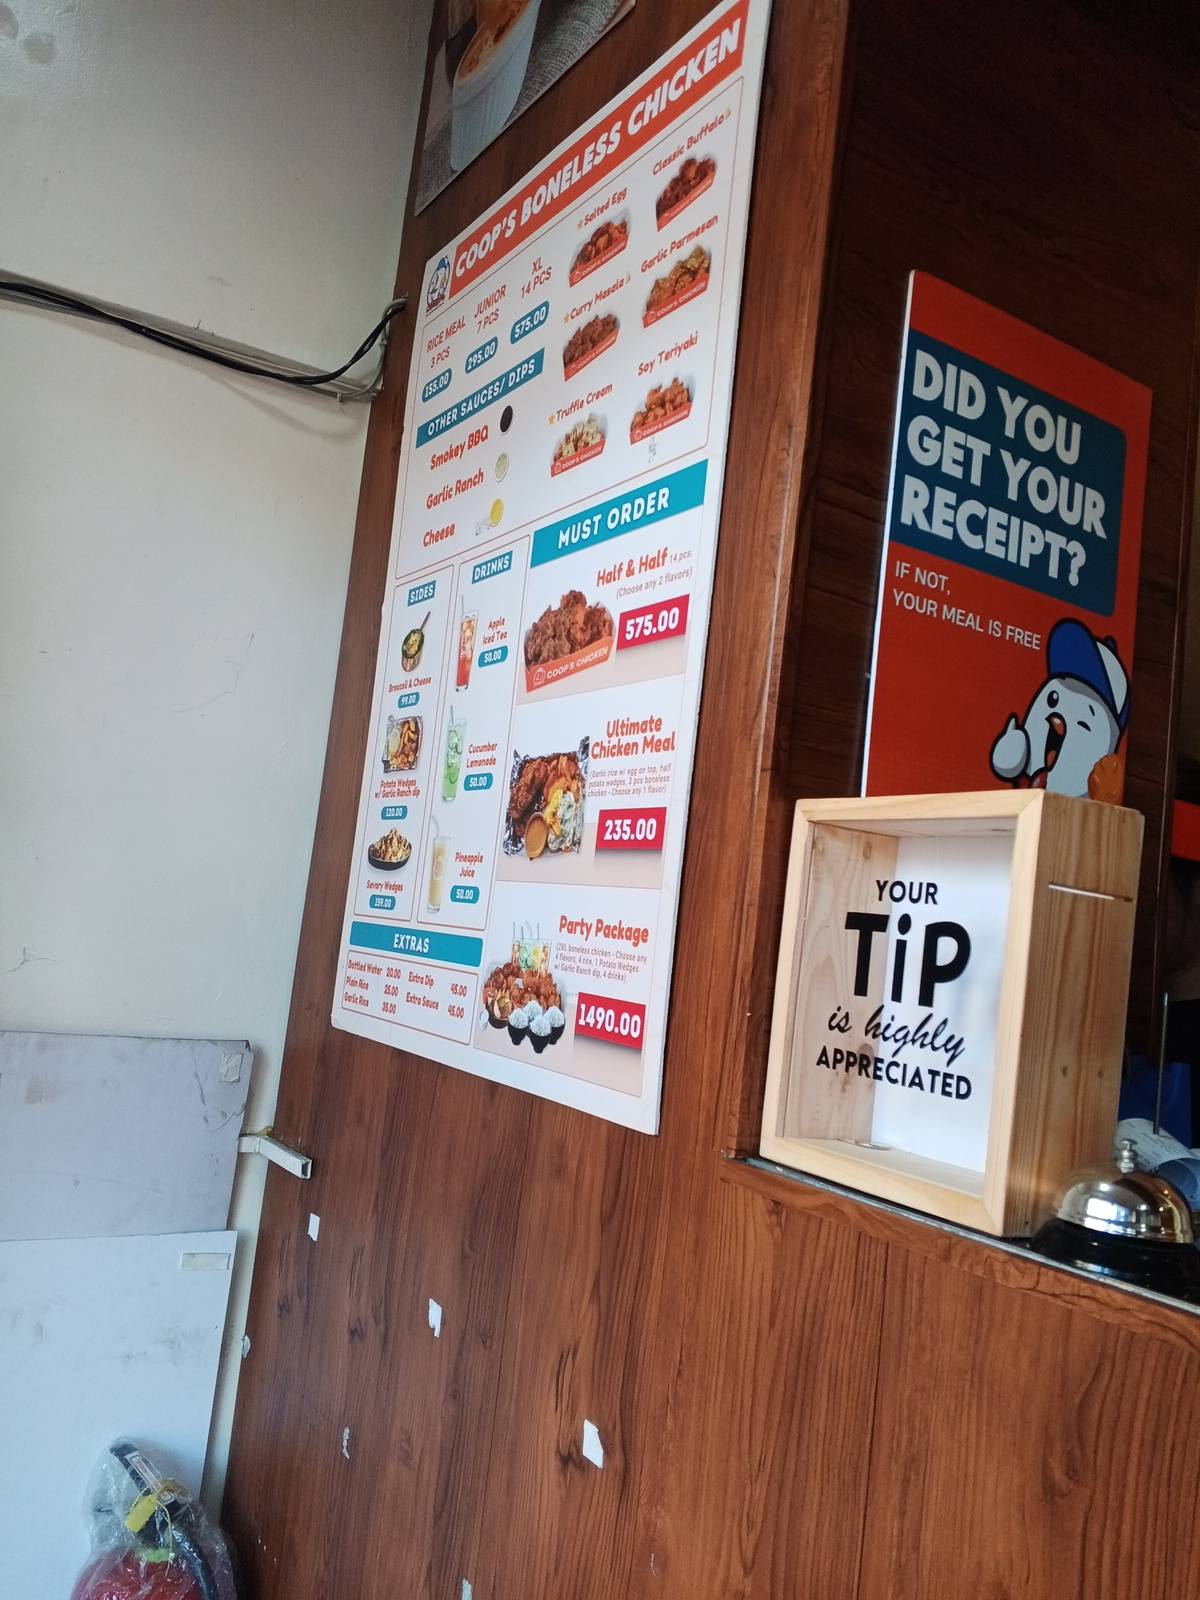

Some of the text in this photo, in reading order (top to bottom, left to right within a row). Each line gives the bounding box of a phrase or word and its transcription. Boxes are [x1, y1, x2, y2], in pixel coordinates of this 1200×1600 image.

[455, 19, 740, 278] COOP'S BONELESS CHICKEN
[653, 115, 724, 175] Classic Buffalo
[584, 187, 627, 226] Salted Egg
[640, 248, 668, 273] Garlic
[669, 215, 718, 253] Parmesan
[531, 257, 543, 275] XL
[520, 266, 552, 298] 14 PCS
[474, 285, 507, 317] JUNIOR
[570, 278, 624, 320] Curry Masala
[427, 315, 466, 353] RICE MEAL
[476, 309, 499, 334] 7 PCS
[514, 305, 547, 338] 575.00
[430, 346, 450, 369] 3 PCS
[467, 342, 496, 371] 295.00
[638, 331, 698, 376] Soy Teriyaki
[424, 371, 449, 398] 155.00
[427, 409, 458, 436] OTHER
[508, 358, 536, 388] DIPS
[556, 384, 613, 421] Truffle Cream
[913, 349, 1081, 465] DID YOU
[430, 424, 489, 470] Smokey BBQ
[426, 468, 484, 510] Garlic Ranch
[907, 415, 1107, 539] GET YOUR
[558, 487, 670, 549] MUST ORDER
[901, 474, 1086, 587] RECEIPT?
[423, 523, 455, 548] Cheese
[474, 555, 510, 580] DRINKS
[596, 547, 669, 587] Half & Half
[669, 554, 678, 564] 14
[616, 567, 693, 600] (Choose any 2 flavors)
[895, 561, 950, 595] IF NOT,
[409, 585, 434, 603] SIDES
[488, 616, 505, 631] Apple
[625, 607, 679, 641] 575.00
[893, 589, 1041, 650] YOUR MEAL IS FREE
[483, 631, 508, 645] Iced Tea
[484, 650, 502, 663] 50.00
[576, 646, 609, 666] CHICKEN
[388, 677, 432, 693] Broccoli & Cheese
[401, 694, 416, 706] 99.00
[606, 715, 663, 739] Ultimate
[468, 742, 498, 754] Cucumber
[591, 731, 676, 760] Chicken Meal
[466, 756, 497, 769] Lemonade
[380, 779, 417, 790] Potato Wedges
[469, 776, 487, 787] 50.00
[604, 818, 657, 841] 235.00
[455, 852, 484, 866] Pineapple
[459, 867, 475, 878] Juice
[366, 880, 403, 893] Savory Wedges
[455, 889, 474, 900] 50.00
[876, 880, 938, 905] YOUR
[393, 933, 430, 953] EXTRAS
[559, 915, 649, 948] Party Package
[348, 960, 382, 976] Bottled Water
[386, 968, 401, 980] 20.00
[408, 972, 434, 989] Extra Dip
[346, 976, 369, 990] Plain Rice
[406, 992, 439, 1010] Extra Sauce
[578, 1003, 641, 1039] 1490.00
[828, 1006, 852, 1034] is
[864, 1004, 965, 1068] highly
[816, 1045, 972, 1100] APPRECIATED
